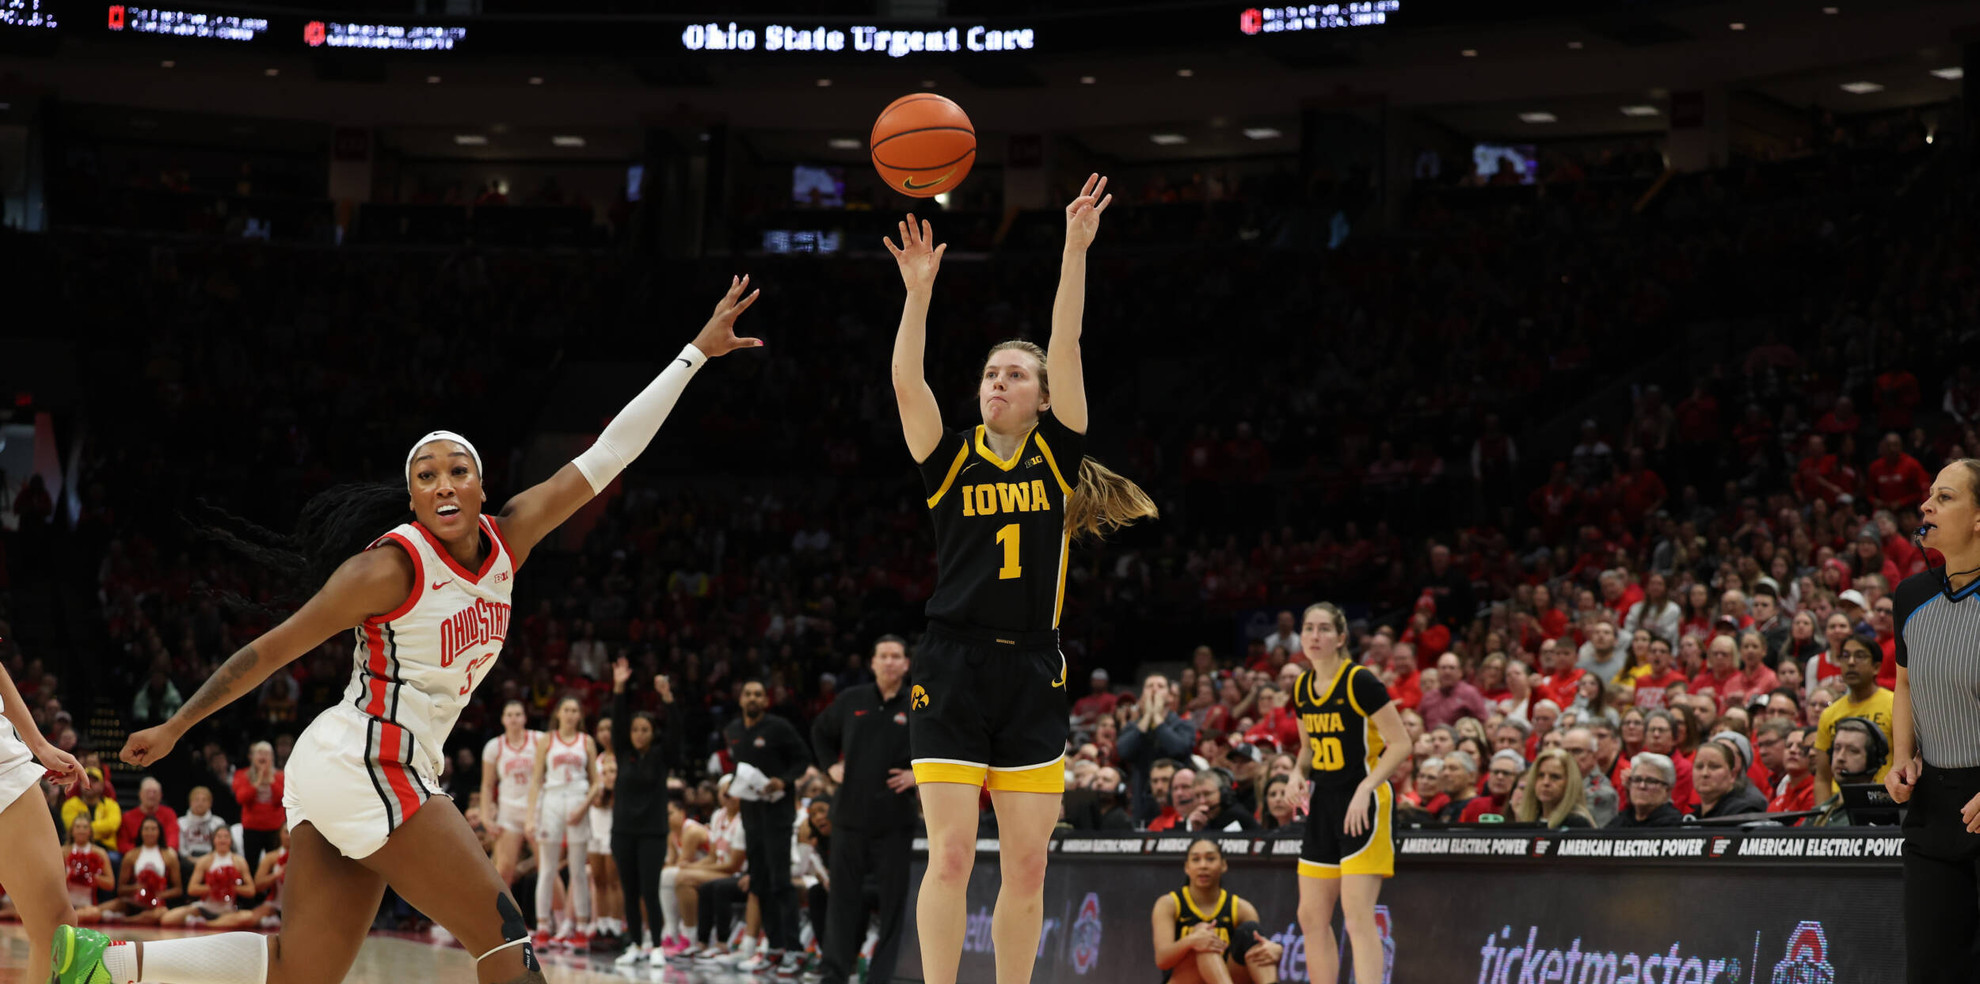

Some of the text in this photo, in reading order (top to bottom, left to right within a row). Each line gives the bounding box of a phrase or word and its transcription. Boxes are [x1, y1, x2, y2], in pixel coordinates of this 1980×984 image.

[683, 22, 1034, 57] Ohio State Urgent Care
[962, 480, 1050, 516] IOWA
[996, 523, 1022, 580] 1
[1302, 712, 1345, 733] OWA
[1310, 736, 1345, 771] 20
[1271, 839, 1303, 854] AMERIC
[1401, 838, 1450, 853] AMERICAN
[1450, 838, 1492, 855] ELECTRIC
[1491, 839, 1529, 855] POWER
[1557, 839, 1612, 856] AMERICAN
[1613, 839, 1661, 856] ELECTRIC
[1661, 839, 1705, 856] POWER
[1738, 838, 1805, 856] AMERICAN
[1805, 838, 1863, 856] ELECTRIC
[1478, 925, 1727, 984] ticketmaster
